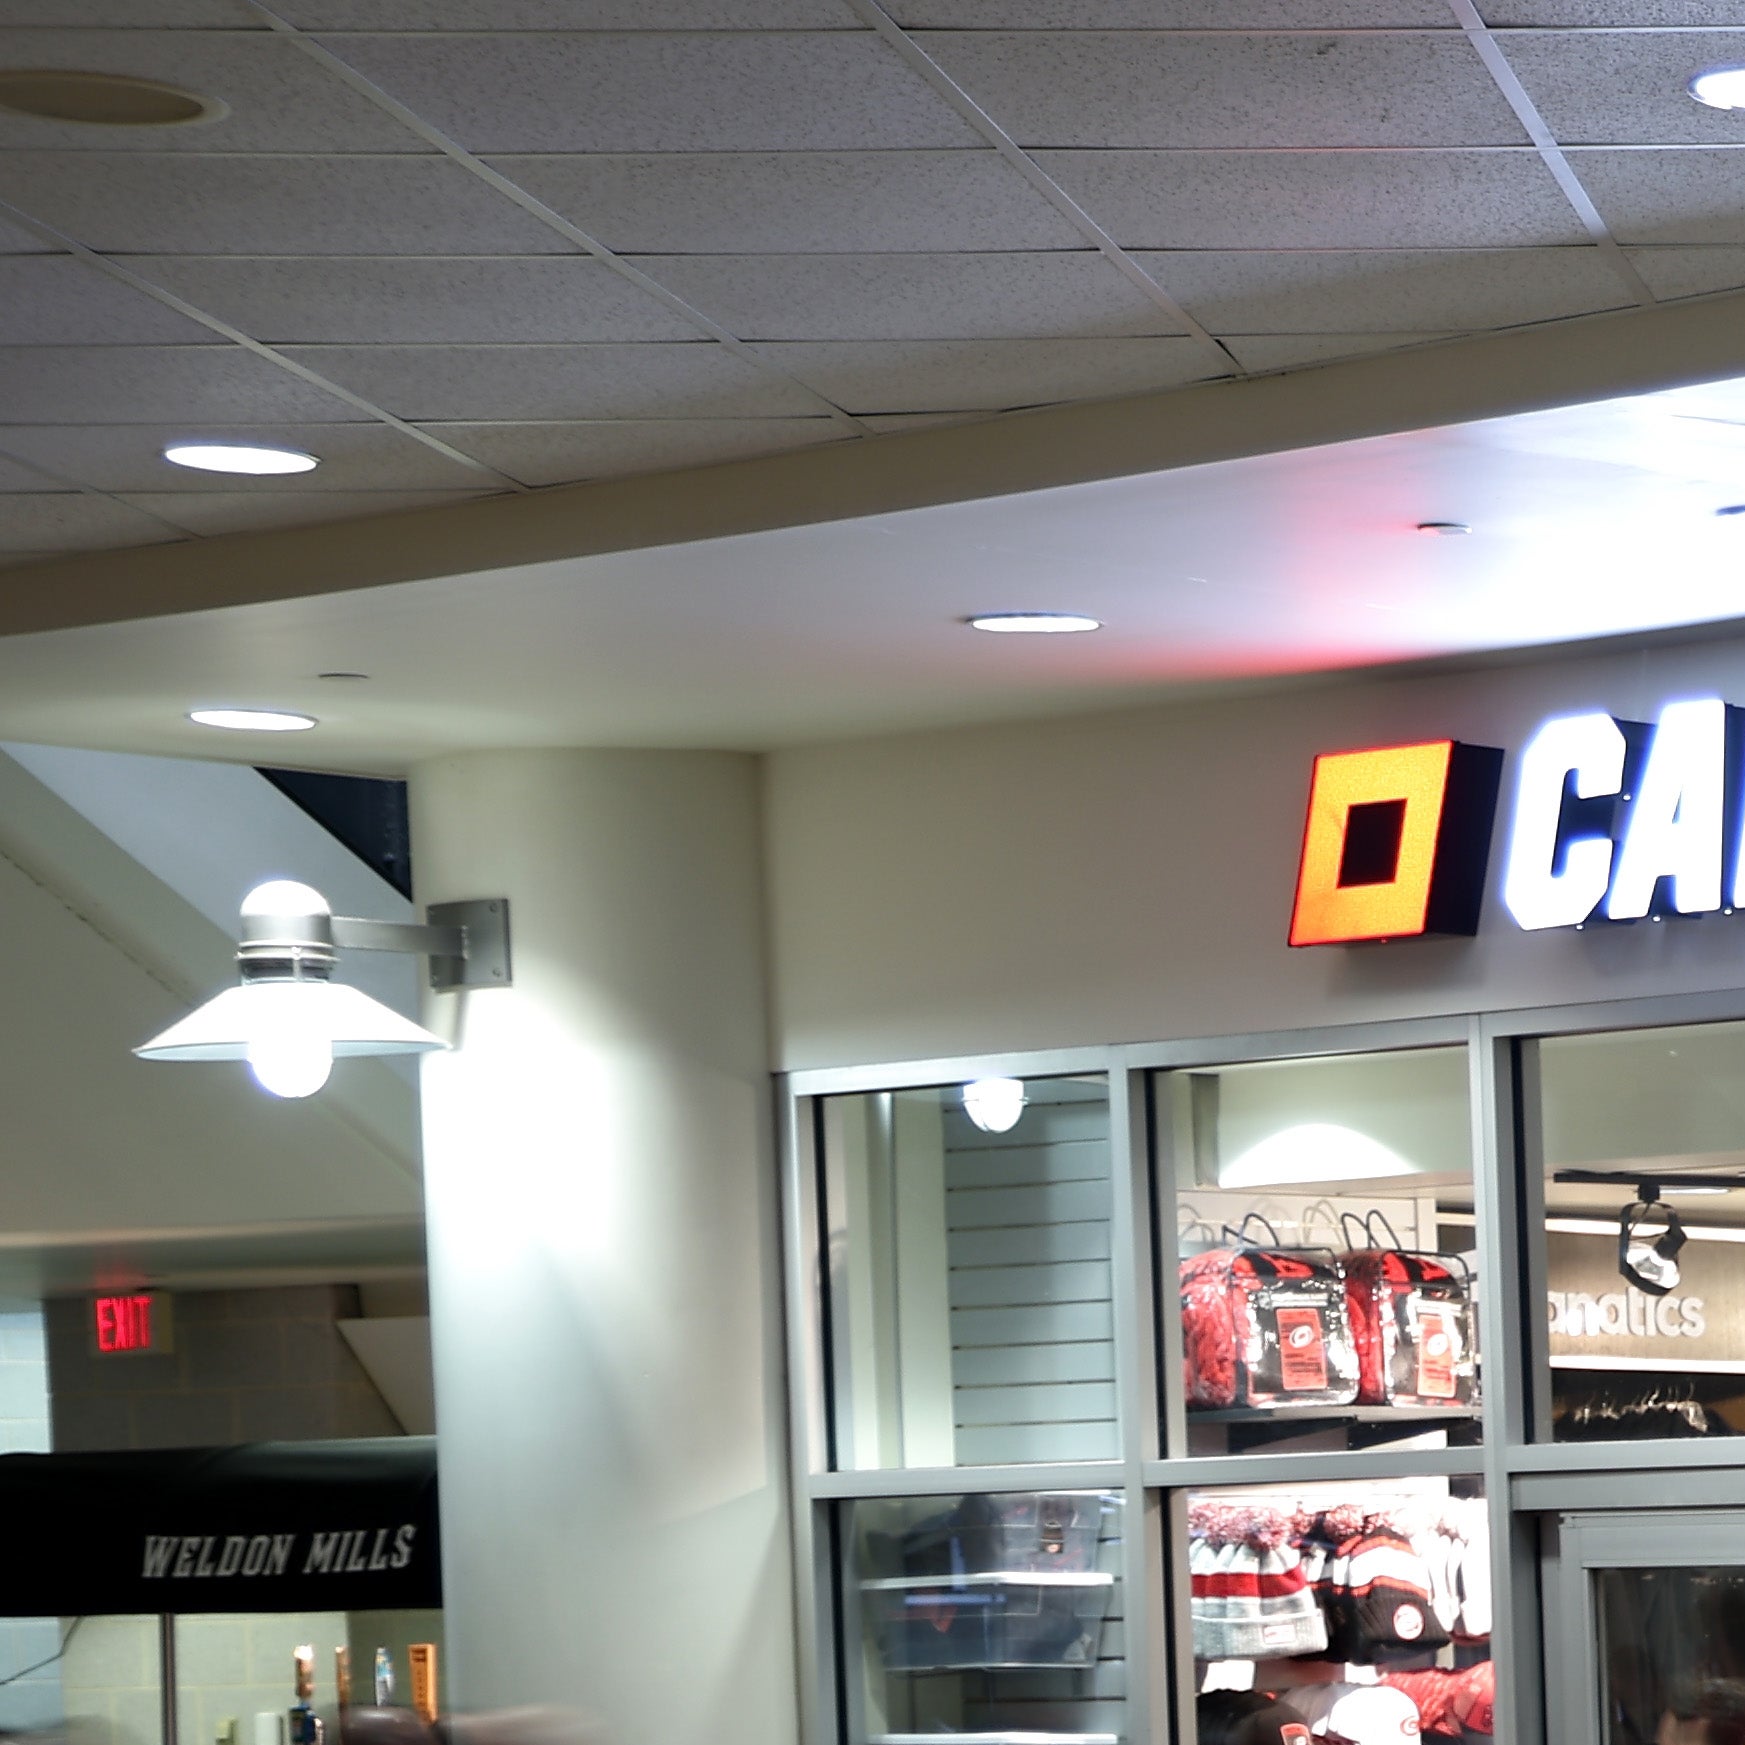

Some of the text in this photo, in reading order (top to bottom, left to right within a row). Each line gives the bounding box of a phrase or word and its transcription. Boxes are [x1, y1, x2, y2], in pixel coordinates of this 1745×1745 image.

[95, 1295, 152, 1353] EXIT
[1547, 1284, 1705, 1338] anatics
[141, 1522, 418, 1581] WELDON MILLS
